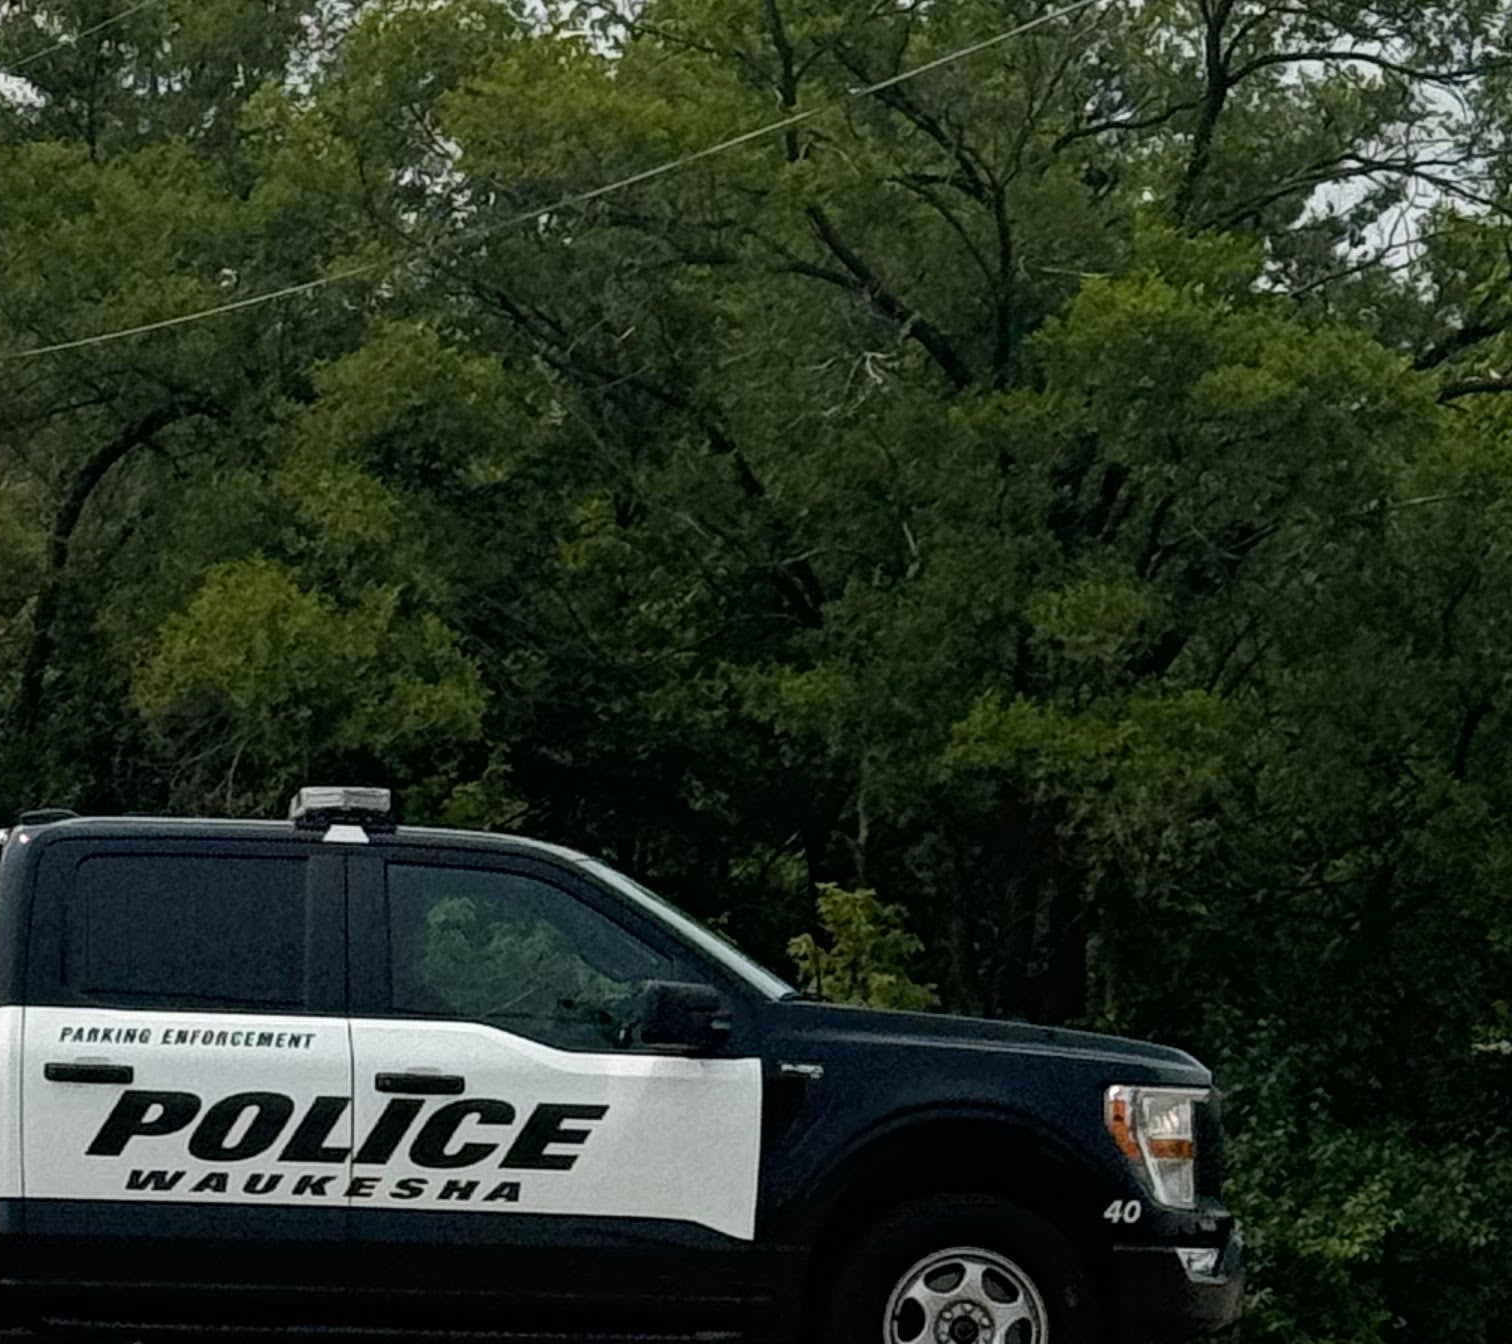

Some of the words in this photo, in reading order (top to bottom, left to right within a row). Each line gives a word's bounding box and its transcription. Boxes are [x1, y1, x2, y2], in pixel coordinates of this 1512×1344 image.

[59, 1027, 152, 1044] PARKING
[161, 1027, 316, 1049] ENFORCEMENT
[85, 1089, 609, 1170] POLICE
[125, 1169, 522, 1203] WAUKESHA
[1103, 1199, 1142, 1224] 40
